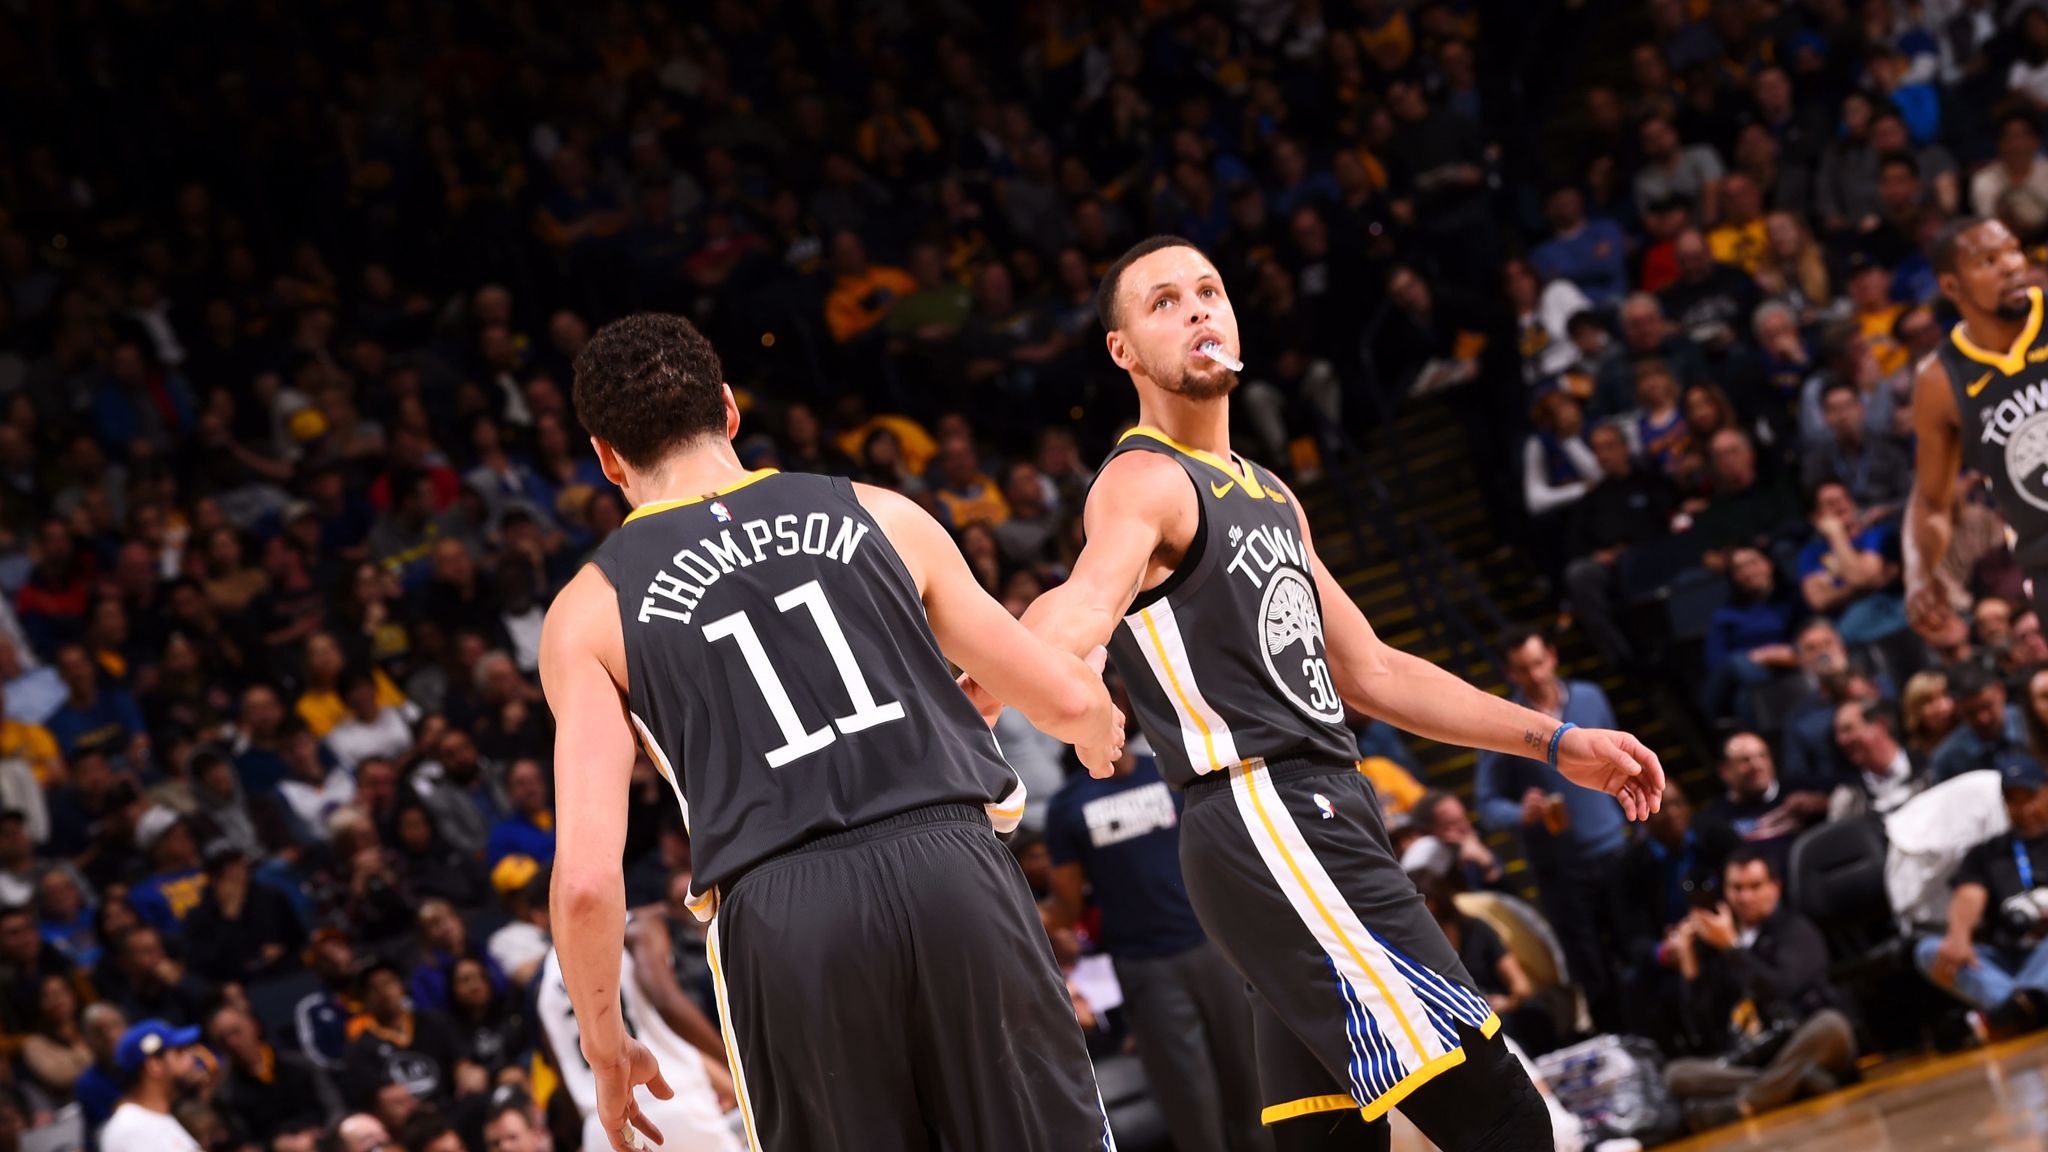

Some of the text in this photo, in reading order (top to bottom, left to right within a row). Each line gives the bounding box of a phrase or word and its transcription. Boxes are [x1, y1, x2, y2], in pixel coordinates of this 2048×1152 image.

[637, 512, 870, 625] THOMPSON
[701, 579, 906, 769] 11
[1302, 658, 1339, 711] 30
